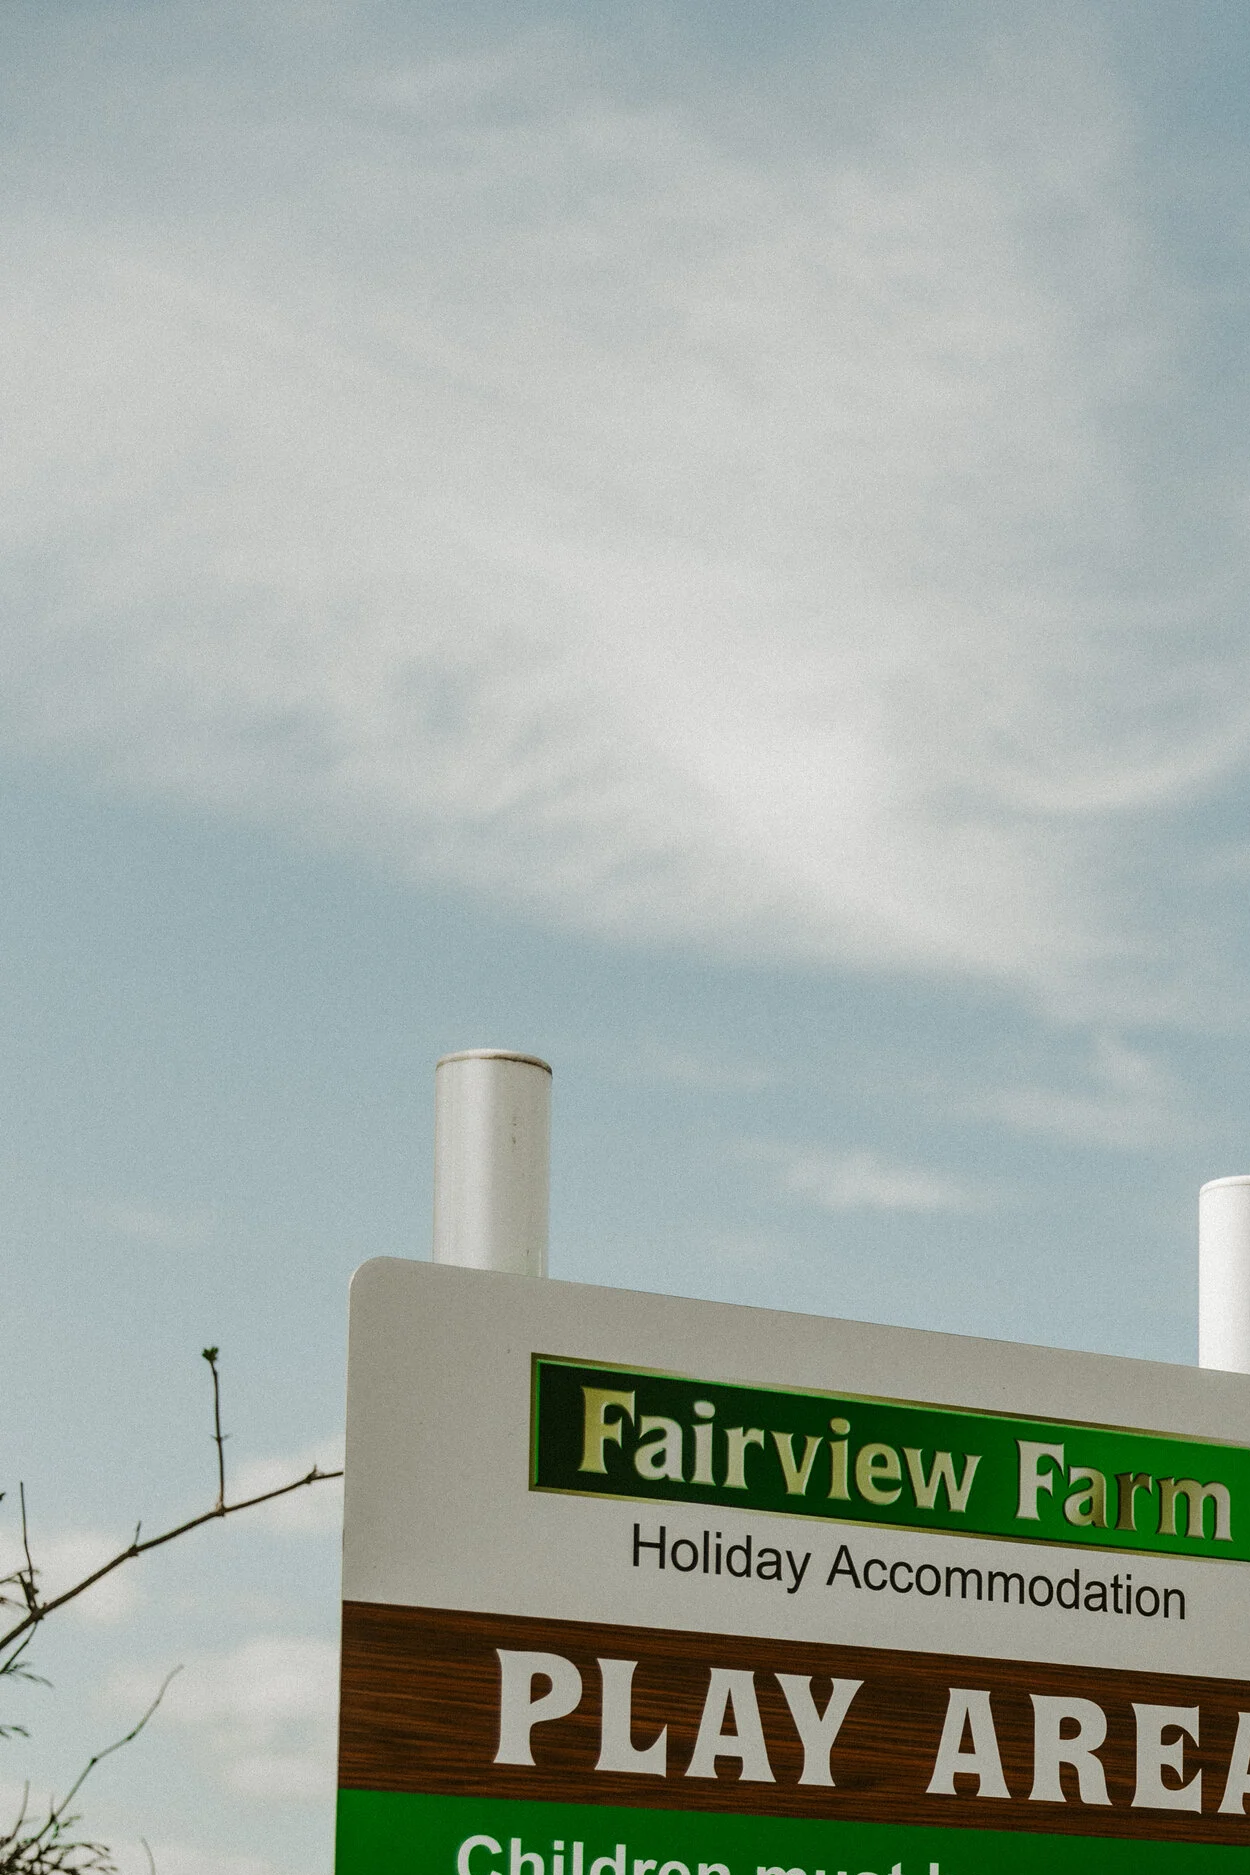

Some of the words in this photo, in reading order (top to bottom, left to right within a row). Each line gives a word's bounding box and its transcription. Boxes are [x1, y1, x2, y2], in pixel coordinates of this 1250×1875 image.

[577, 1386, 981, 1513] Fairview
[1014, 1439, 1233, 1542] Farm
[632, 1522, 812, 1595] Holiday
[825, 1544, 1186, 1620] Accommodation
[493, 1648, 865, 1787] PLAY
